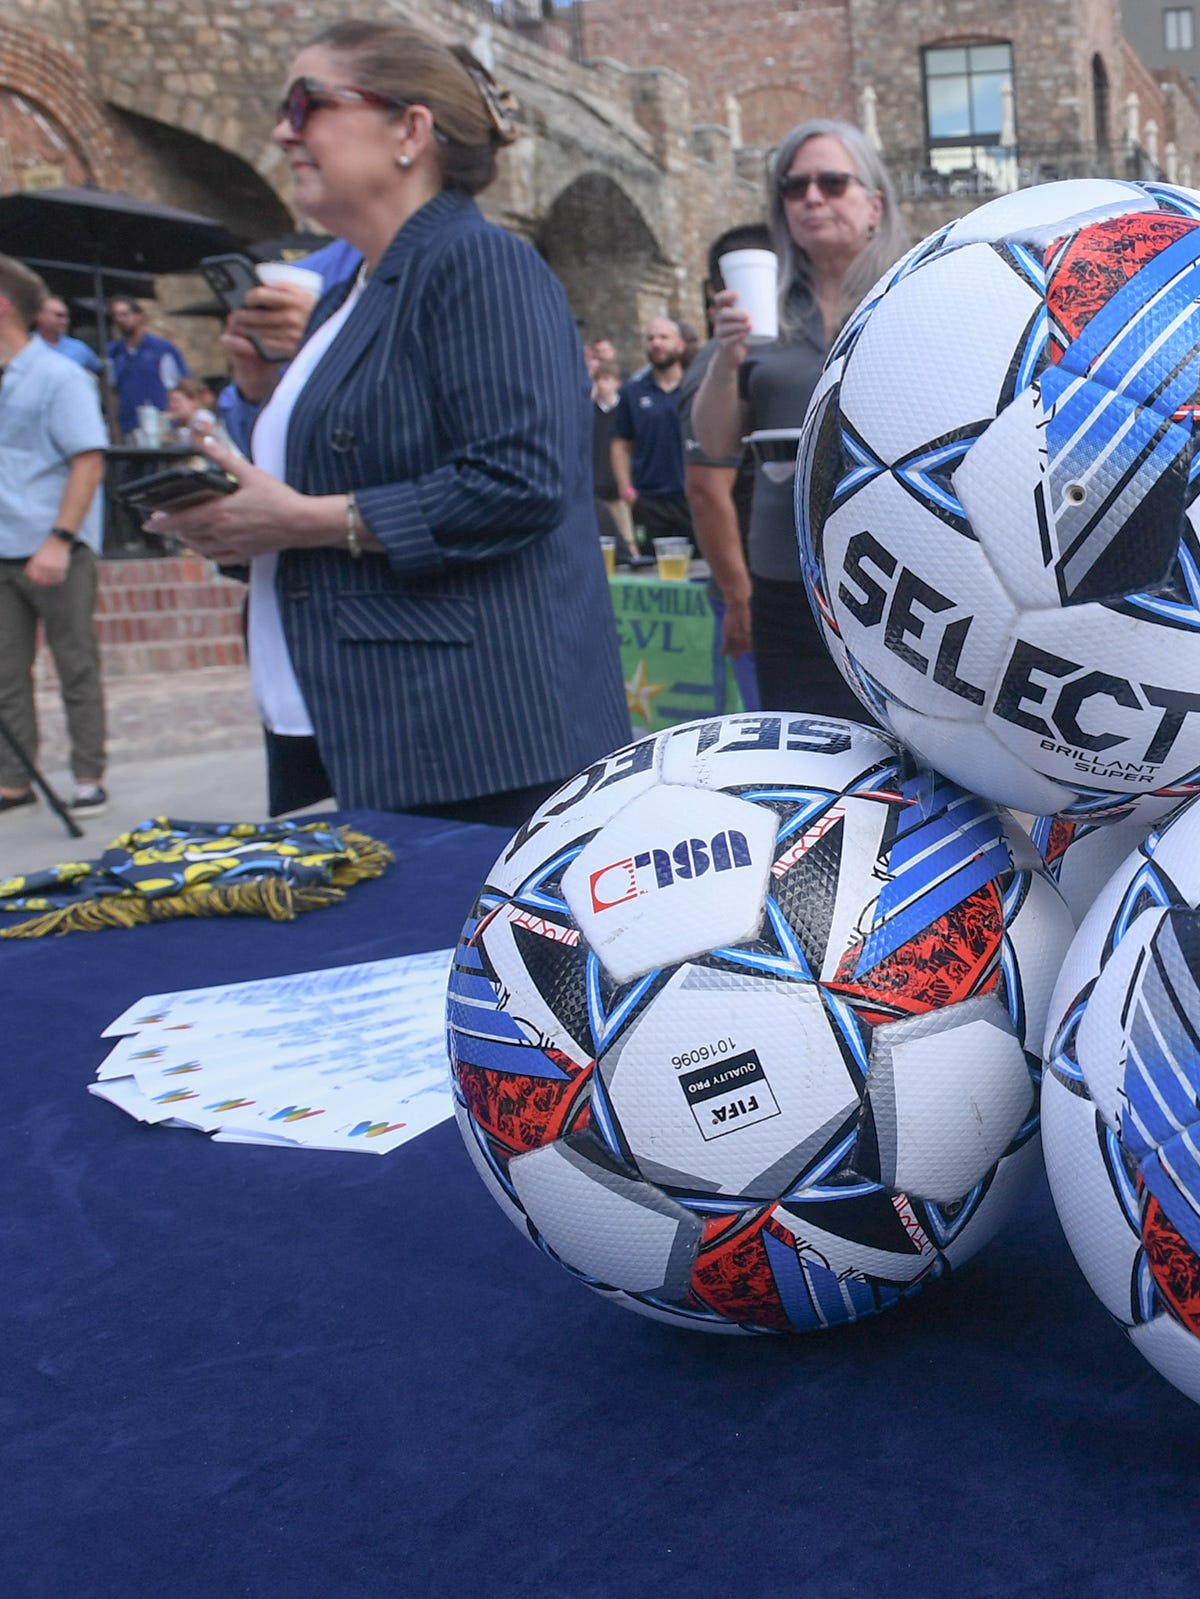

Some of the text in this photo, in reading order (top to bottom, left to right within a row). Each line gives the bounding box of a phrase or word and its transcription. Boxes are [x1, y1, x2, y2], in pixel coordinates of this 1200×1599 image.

[622, 585, 706, 617] FAMILIA
[1040, 739, 1161, 774] BRILLANT
[1074, 762, 1155, 783] SUPER
[633, 830, 753, 889] USL
[671, 1036, 736, 1070] 1016096
[688, 1062, 757, 1094] QUALITY PRO
